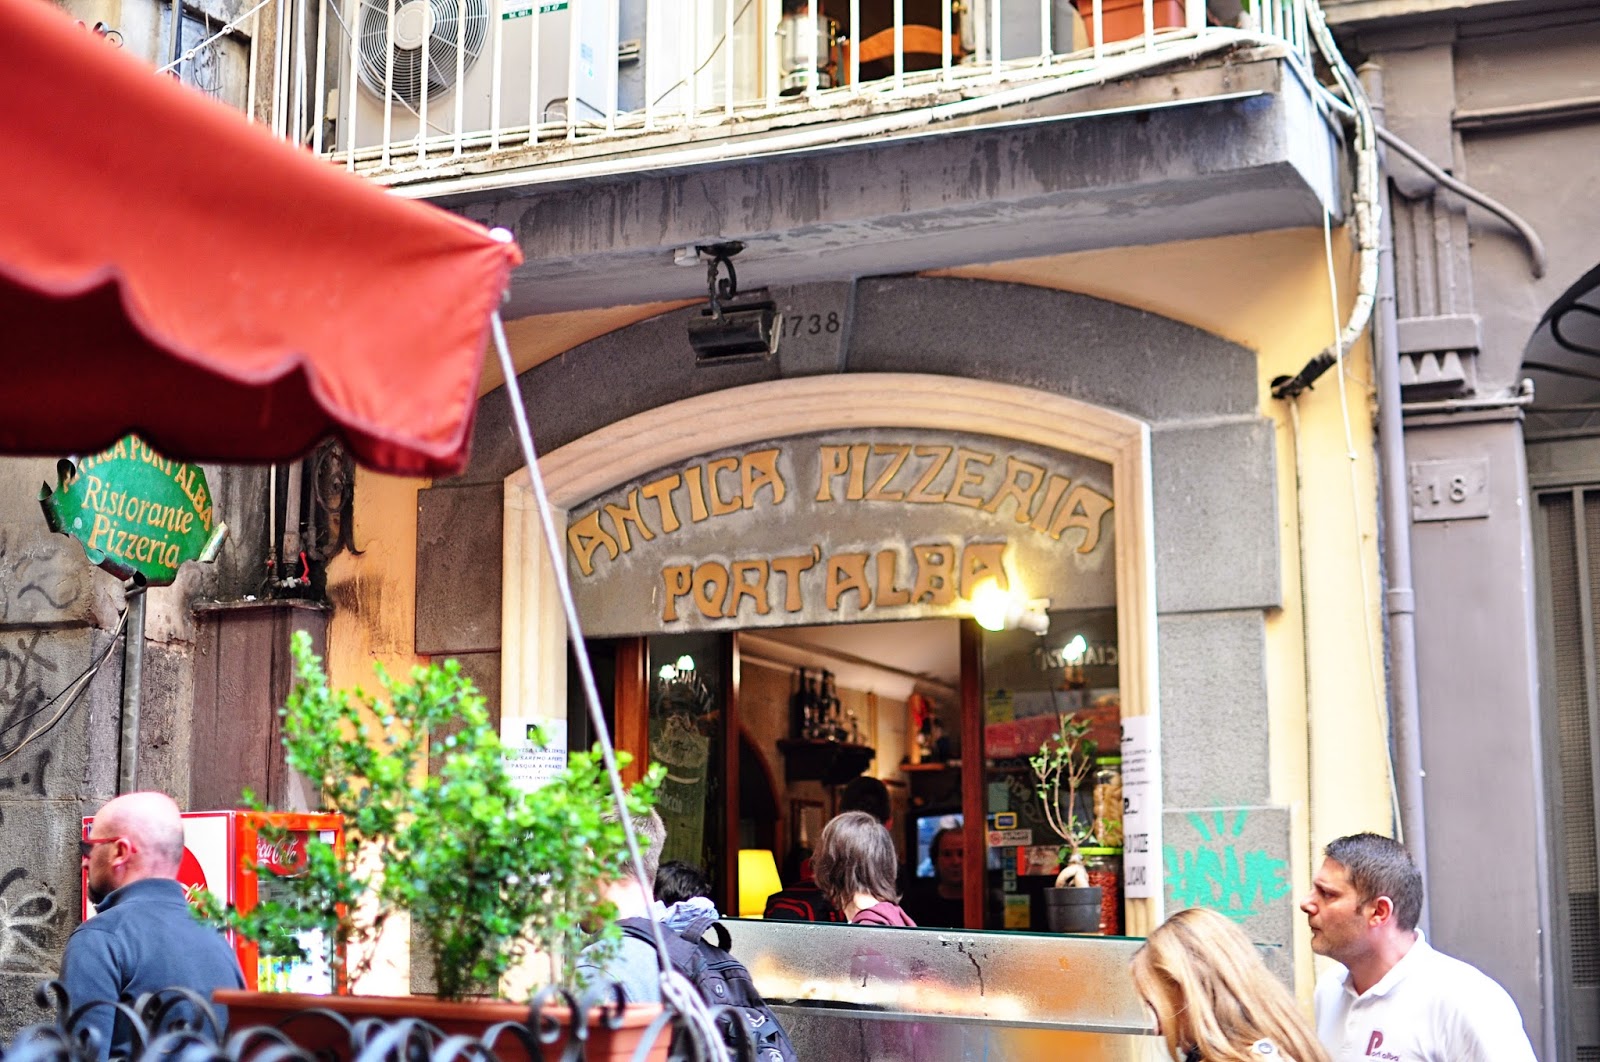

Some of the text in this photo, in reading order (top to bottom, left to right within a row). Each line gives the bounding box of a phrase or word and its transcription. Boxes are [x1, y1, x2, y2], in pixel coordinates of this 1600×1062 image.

[780, 311, 840, 338] 1738
[81, 475, 194, 534] Ristorante
[567, 443, 1115, 577] ANTICA PIZZERIA
[1427, 475, 1468, 505] 18
[87, 513, 180, 570] Pizzeria
[662, 543, 1010, 622] PORT'ALBA
